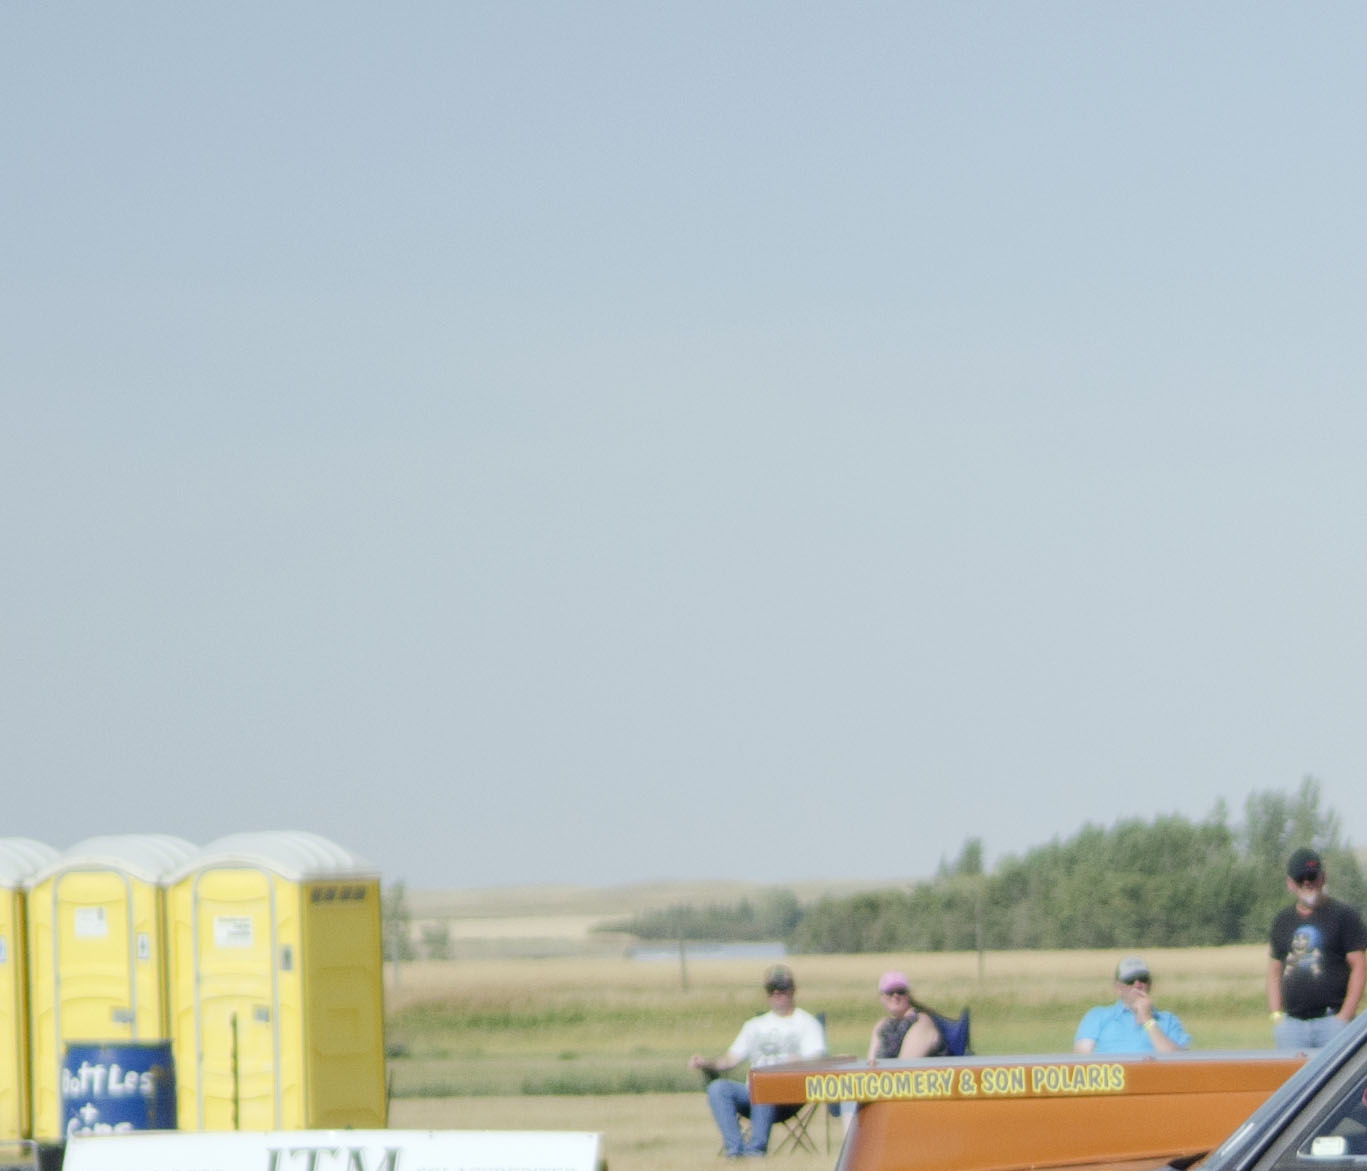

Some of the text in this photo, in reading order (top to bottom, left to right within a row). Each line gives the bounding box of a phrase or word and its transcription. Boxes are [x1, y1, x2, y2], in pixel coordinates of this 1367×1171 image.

[805, 1064, 1126, 1100] MONTGOMERY & SON POLARIS
